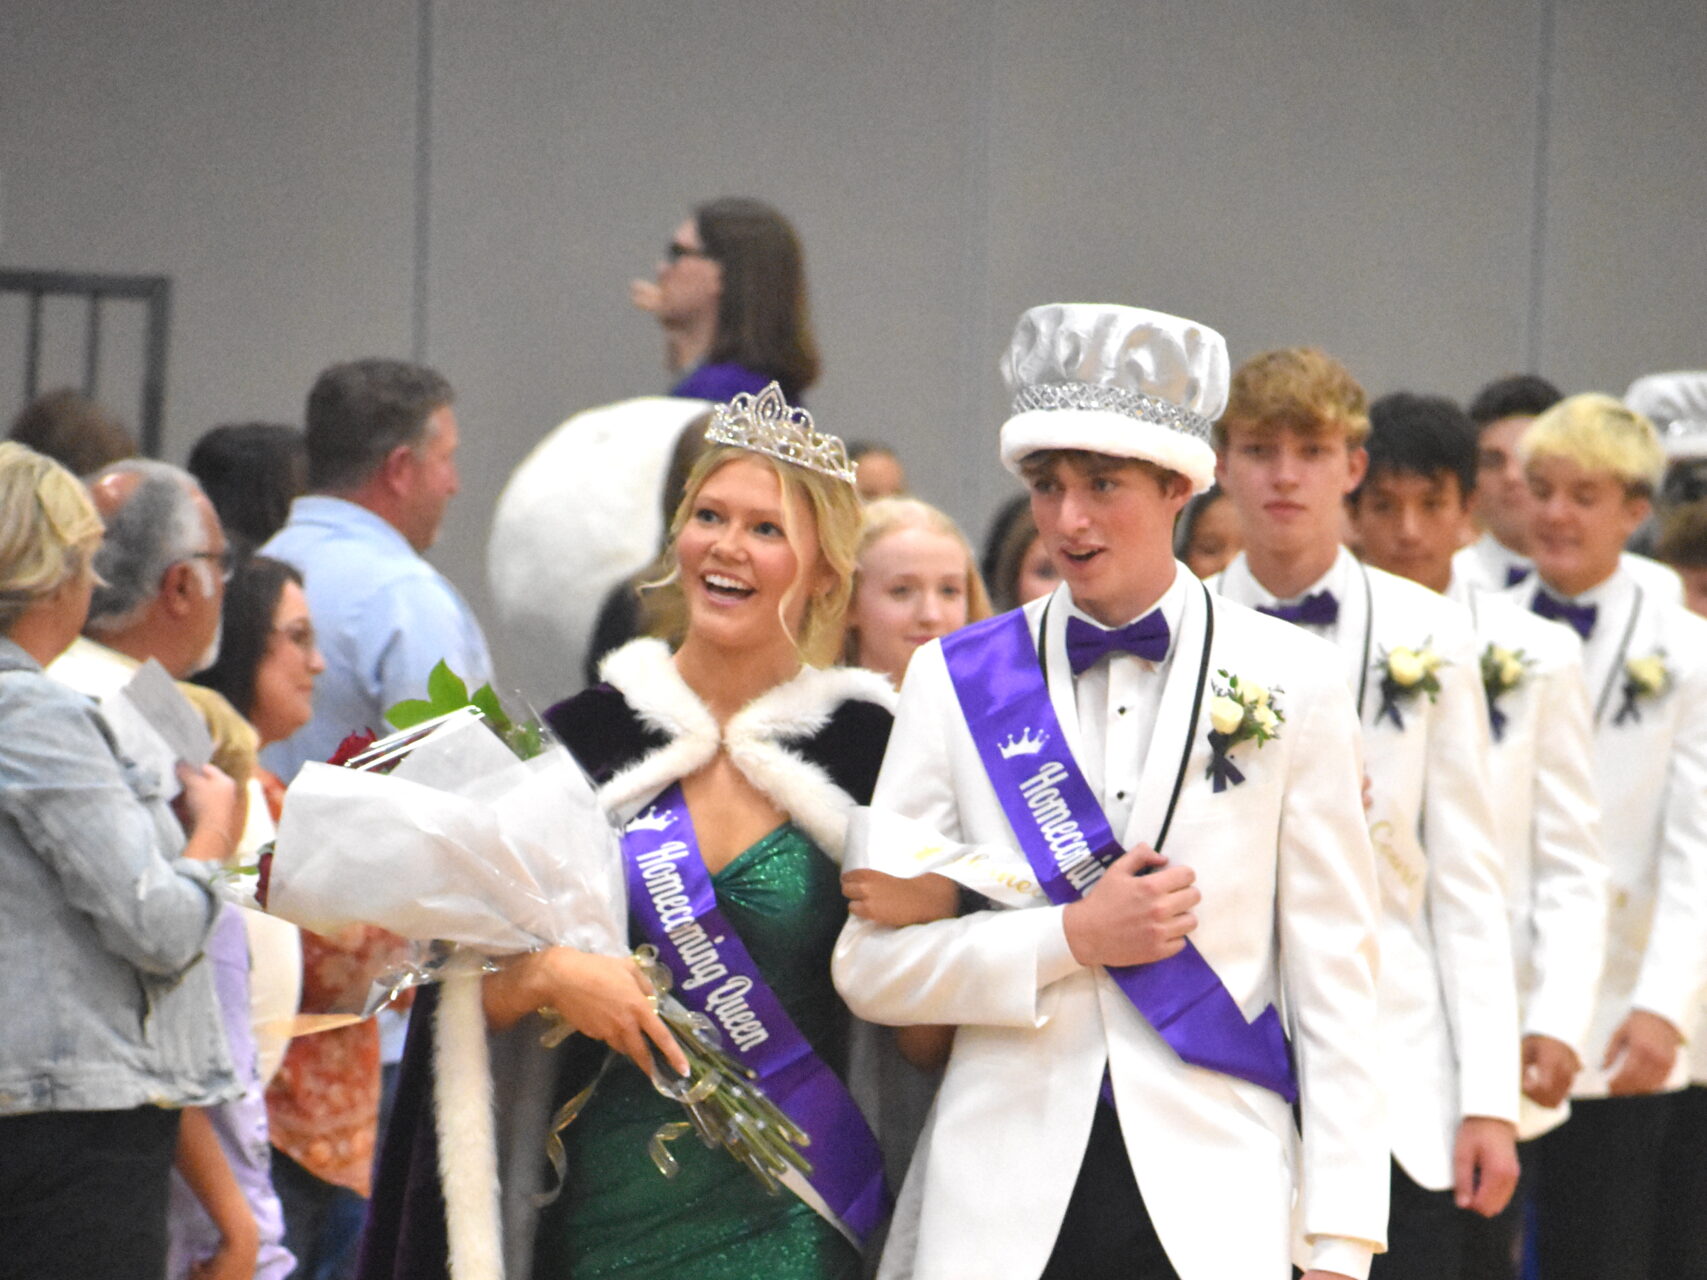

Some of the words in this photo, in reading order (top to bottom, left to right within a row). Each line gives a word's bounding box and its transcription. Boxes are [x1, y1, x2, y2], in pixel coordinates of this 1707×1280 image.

[1019, 761, 1113, 898] Homecomin
[635, 840, 729, 990] Homecoming
[705, 975, 770, 1053] Queen
